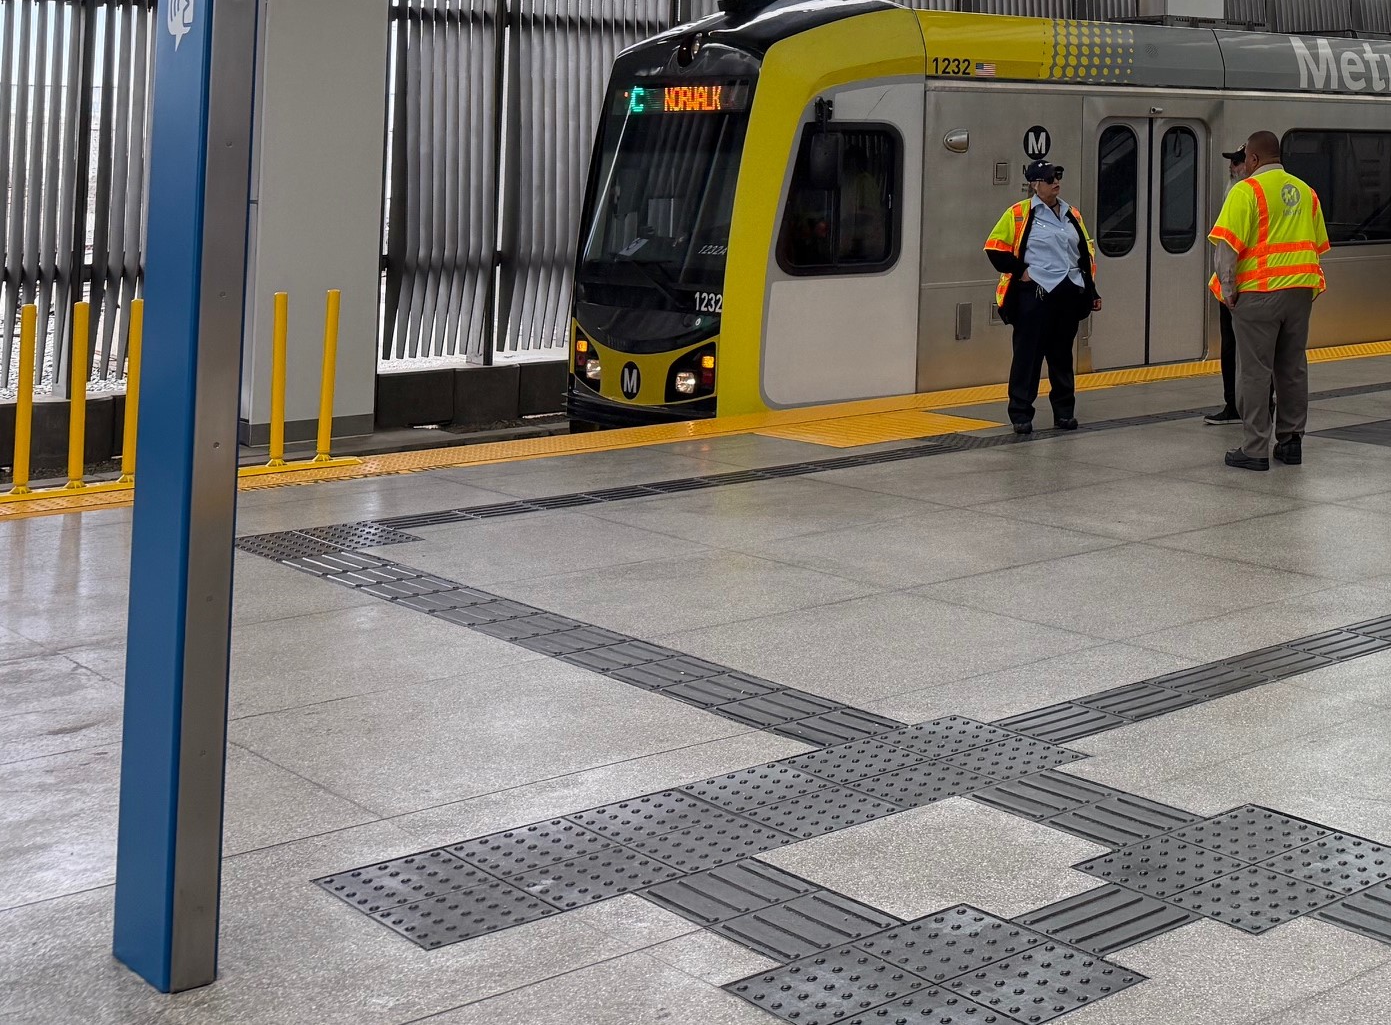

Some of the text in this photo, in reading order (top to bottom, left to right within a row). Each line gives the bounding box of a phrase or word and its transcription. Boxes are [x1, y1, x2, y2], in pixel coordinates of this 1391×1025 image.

[932, 57, 971, 75] 1232
[630, 85, 722, 112] C NORWALK
[1027, 130, 1047, 155] M
[694, 290, 723, 313] 1232
[622, 366, 638, 395] M
